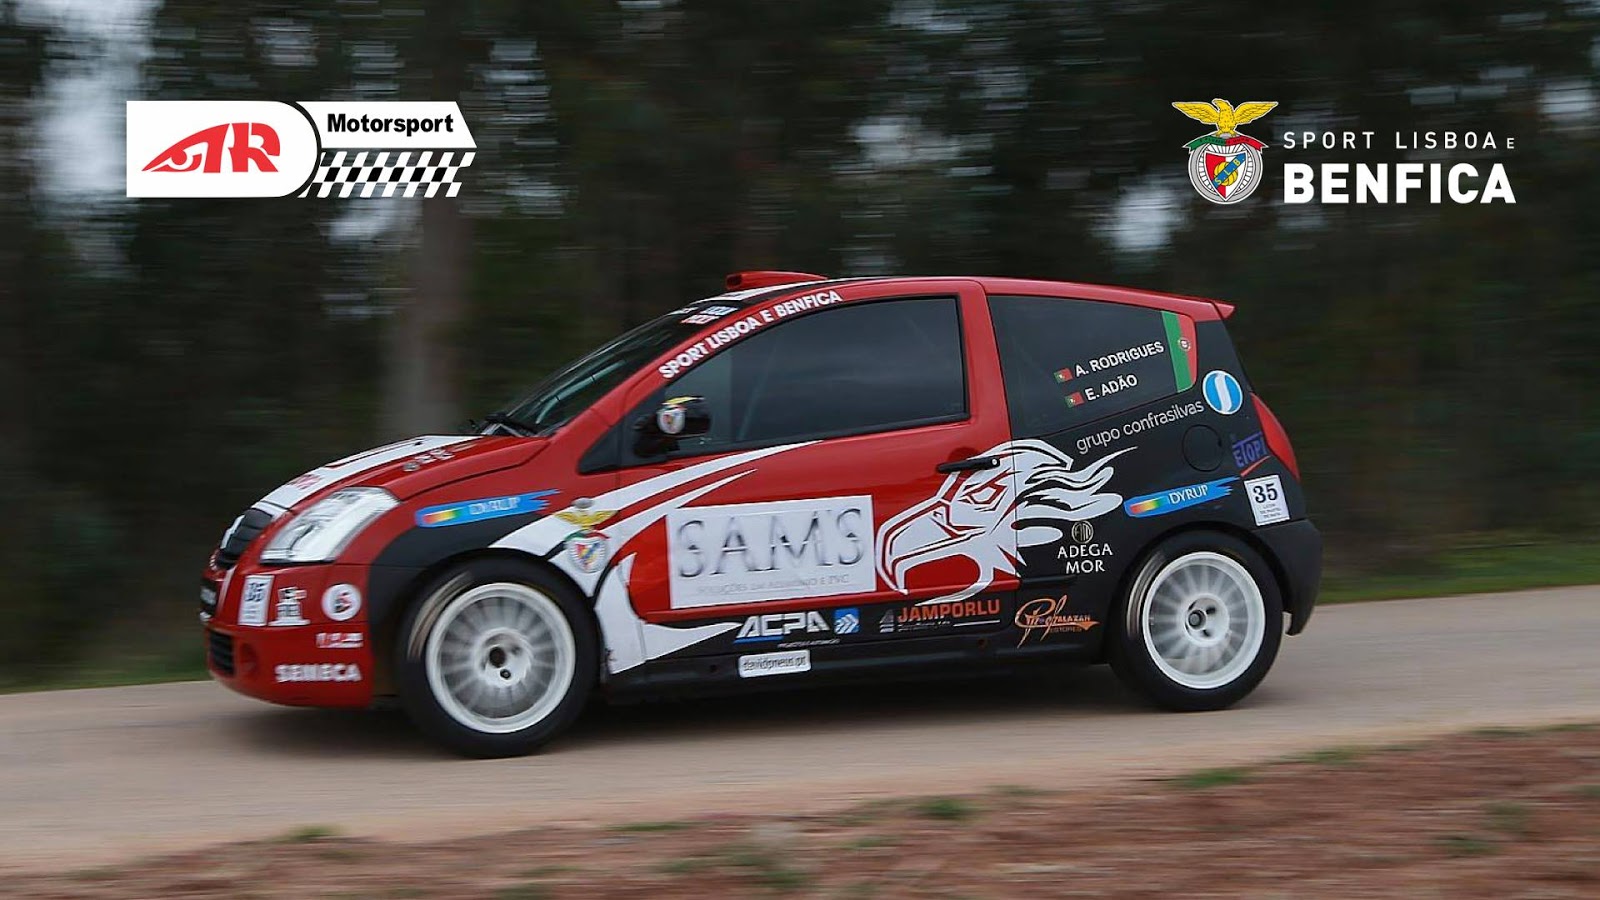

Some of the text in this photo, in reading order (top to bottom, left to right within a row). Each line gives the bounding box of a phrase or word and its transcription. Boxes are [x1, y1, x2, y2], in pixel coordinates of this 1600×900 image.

[658, 342, 709, 378] SPORT
[707, 317, 762, 349] LISBOA
[759, 308, 777, 324] E
[774, 289, 843, 319] BENFICA
[1074, 340, 1165, 378] A. RODRIGUES
[1084, 373, 1139, 402] E. ADÃO
[1076, 399, 1205, 455] grupo confrasilvas
[1169, 485, 1209, 505] DYRUP
[1253, 483, 1278, 503] 35
[677, 507, 864, 579] SAMS
[1057, 543, 1113, 559] ADEGA
[1065, 559, 1106, 574] MOR
[898, 599, 1000, 623] JAMPORLU
[736, 611, 830, 638] ACPA
[275, 663, 362, 682] SENECA
